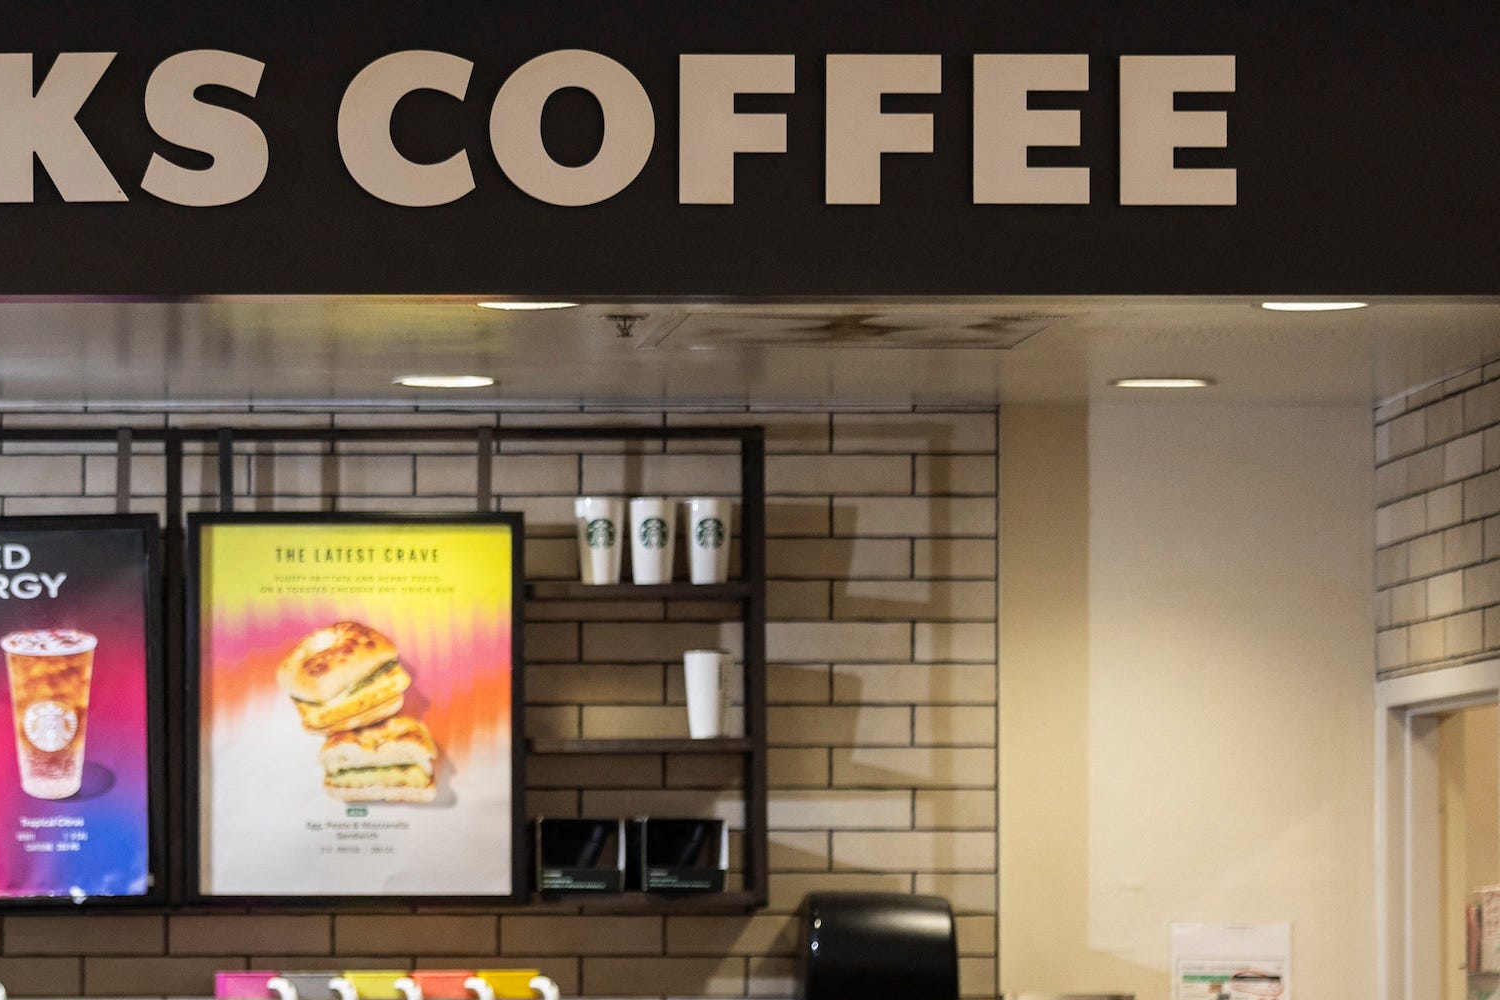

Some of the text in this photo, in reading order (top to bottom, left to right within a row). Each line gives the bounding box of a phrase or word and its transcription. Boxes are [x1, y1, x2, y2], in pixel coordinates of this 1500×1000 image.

[338, 50, 1237, 206] COFFEE
[276, 548, 439, 563] THE LATEST CRAVE
